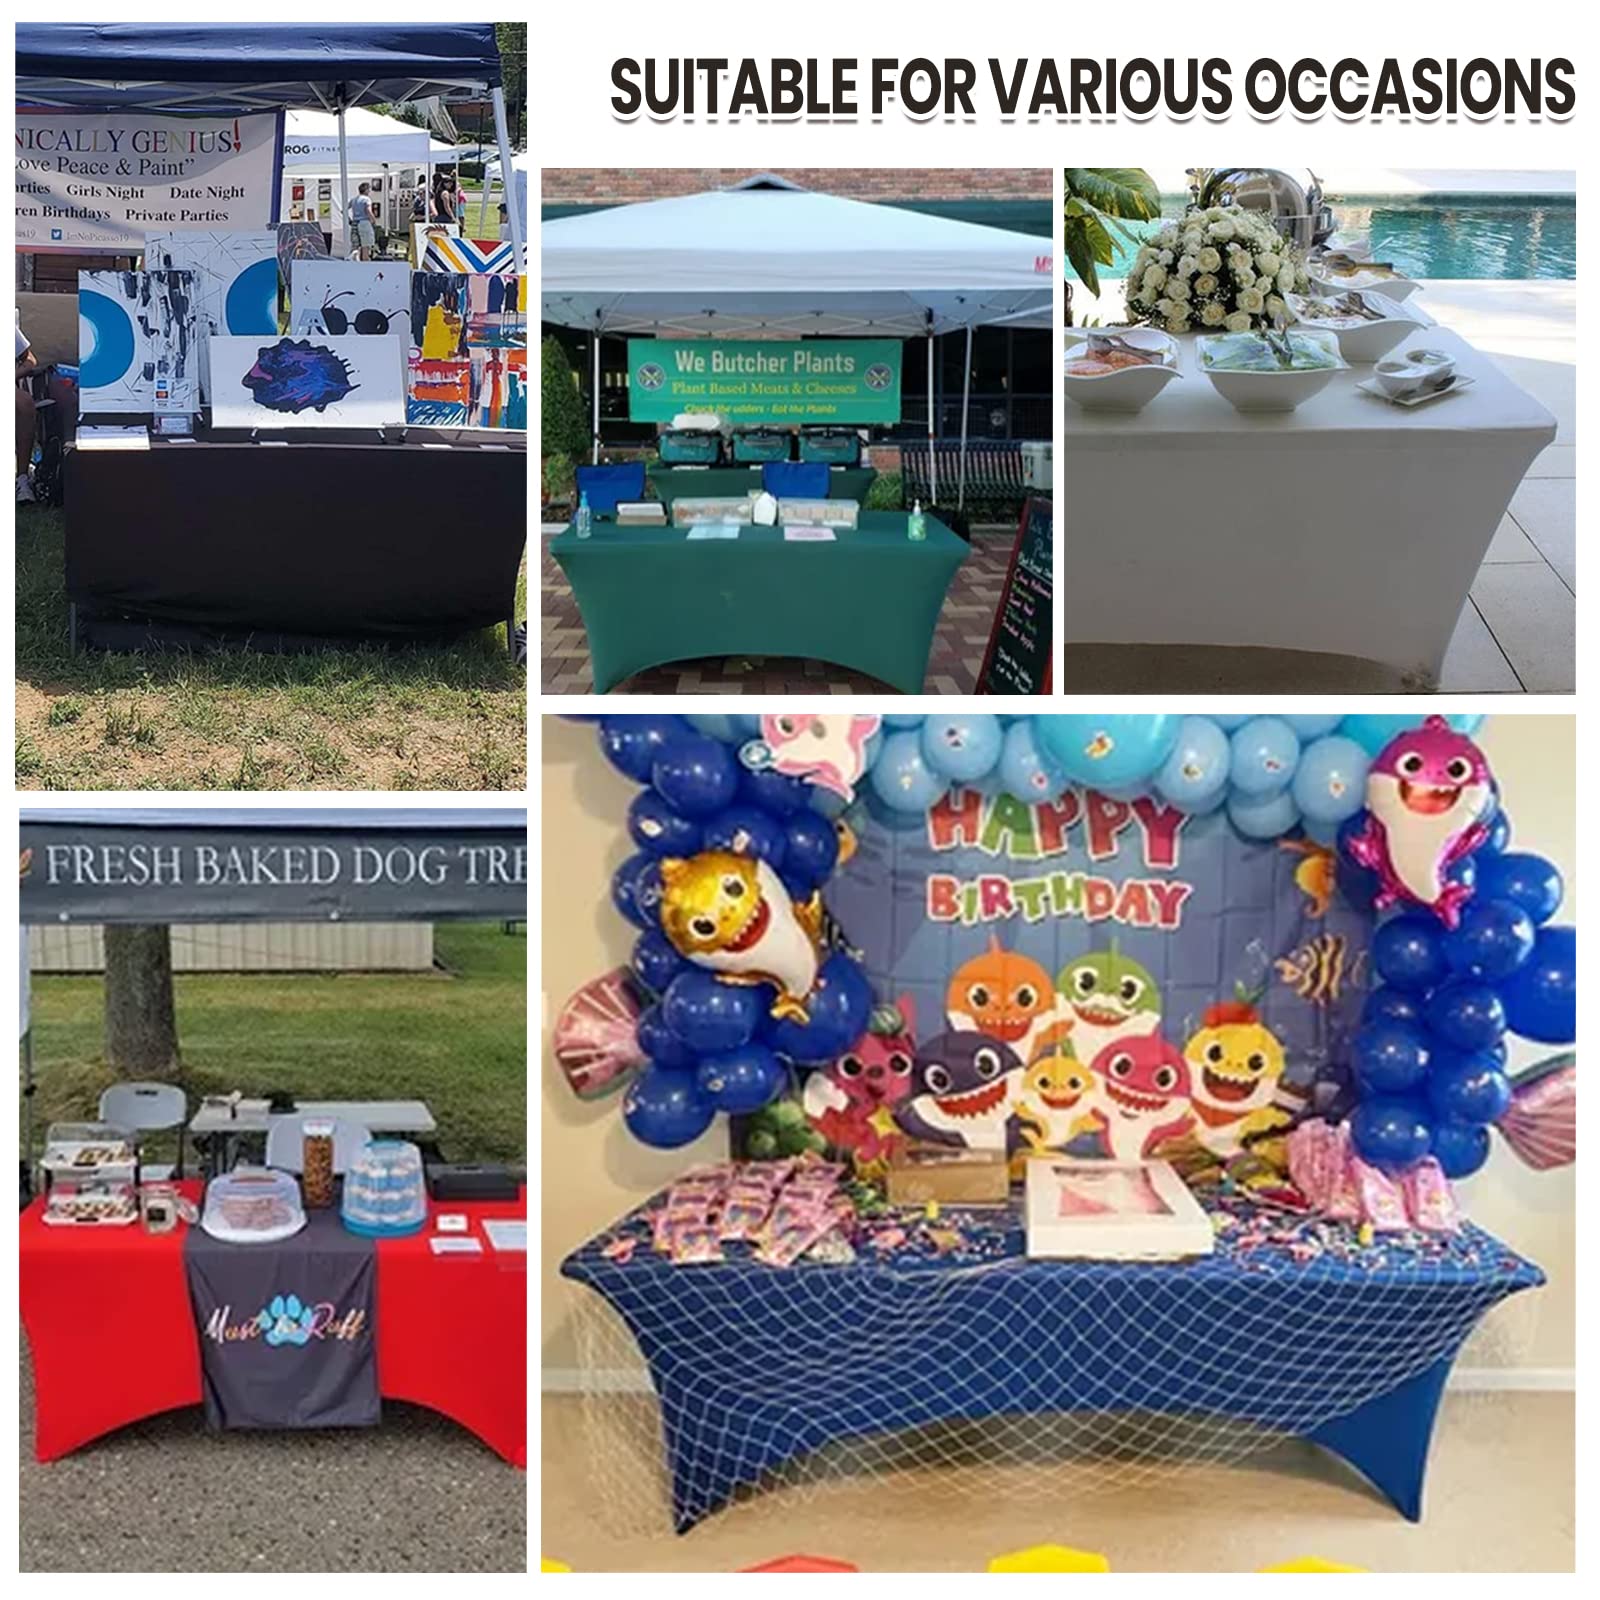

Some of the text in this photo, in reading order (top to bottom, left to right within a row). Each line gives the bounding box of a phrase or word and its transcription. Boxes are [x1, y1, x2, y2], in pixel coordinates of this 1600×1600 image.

[15, 157, 51, 173] ove
[57, 156, 110, 176] Peace
[115, 157, 133, 176] &
[66, 184, 102, 198] Girls
[106, 185, 145, 201] Night
[169, 186, 203, 199] Date
[206, 185, 245, 201] Night
[42, 205, 111, 220] Birthdays
[125, 208, 177, 222] Private
[180, 208, 229, 222] Parties
[674, 349, 856, 374] We Butcher Plants
[671, 380, 858, 396] Plant Based Meats & Cheeses
[926, 786, 1188, 871] HAPPY
[45, 844, 182, 885] FRESH
[196, 845, 342, 885] BAKED
[352, 845, 449, 886] DOG
[926, 873, 1193, 929] BIRTHDAY
